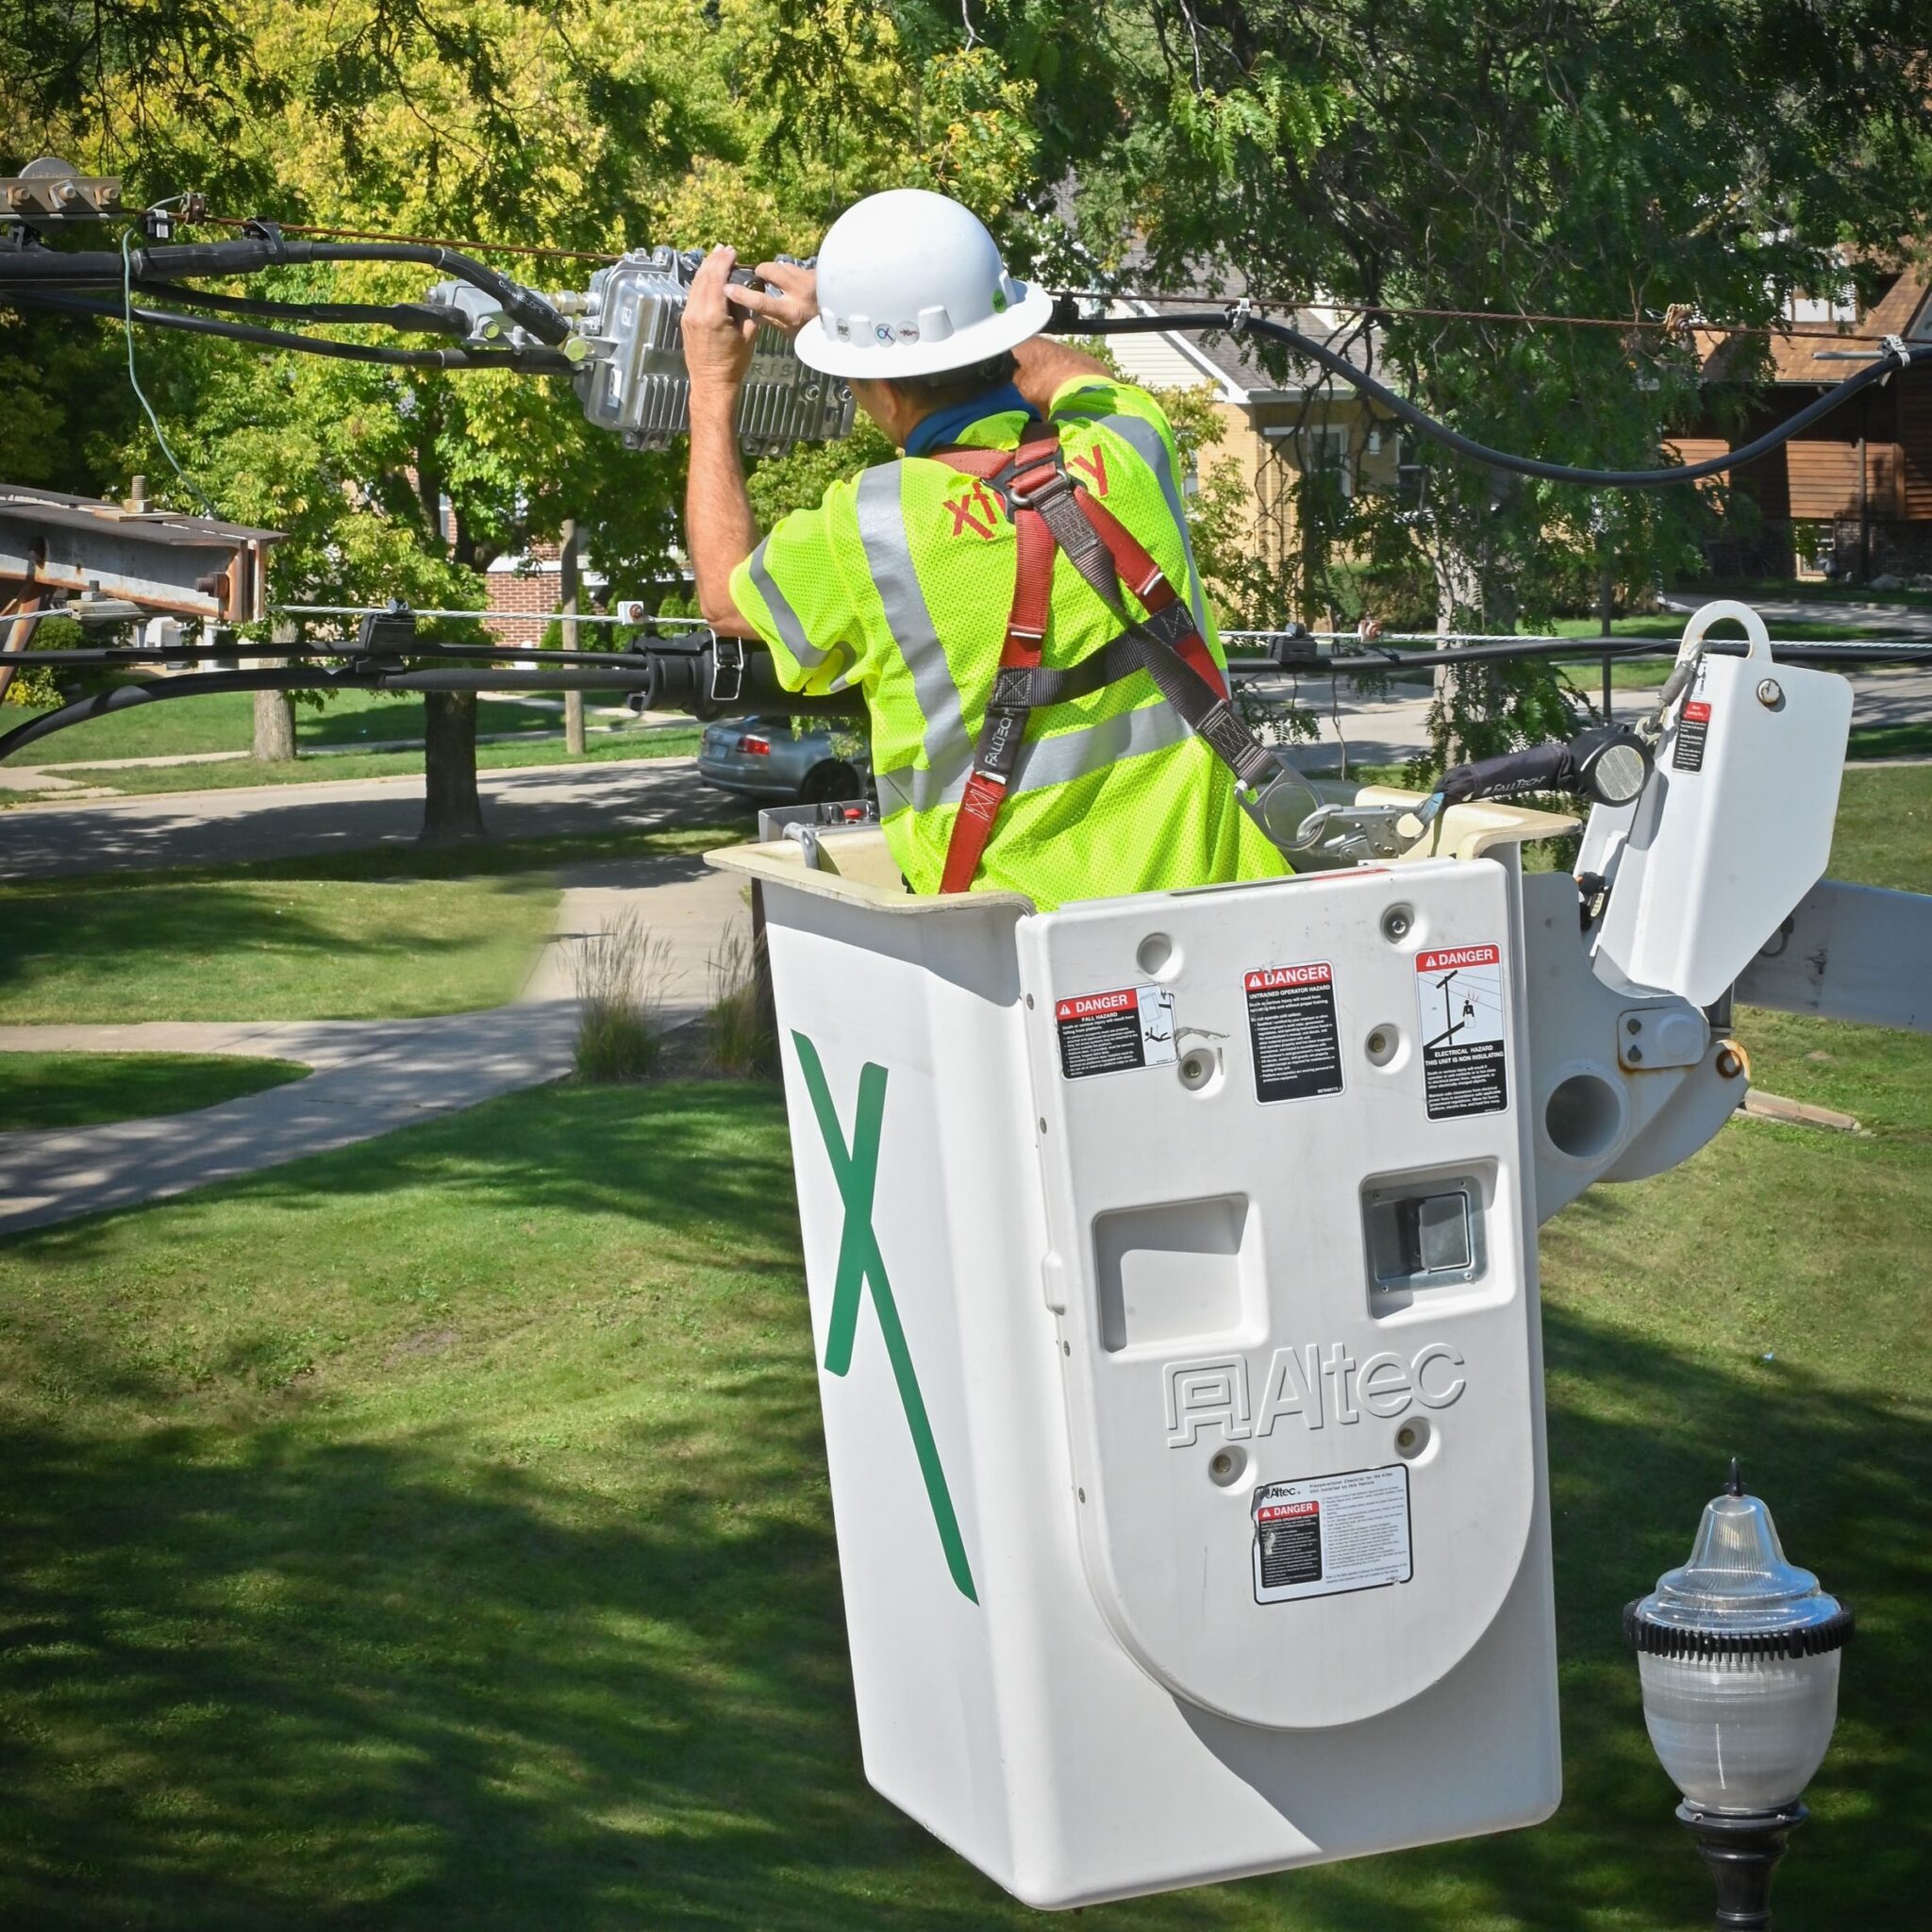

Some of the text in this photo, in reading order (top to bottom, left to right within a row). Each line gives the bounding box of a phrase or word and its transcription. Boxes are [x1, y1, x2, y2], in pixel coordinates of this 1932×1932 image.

[1439, 948, 1493, 966] DANGER
[1264, 966, 1329, 986] DANGER
[1249, 991, 1279, 1000] UNTRAINED
[1280, 988, 1307, 996] OPERATOR
[1075, 994, 1127, 1012] DANGER
[1435, 1048, 1468, 1058] ELECTRICAL
[1255, 1342, 1467, 1437] Altec
[1270, 1487, 1296, 1499] Altec
[1274, 1502, 1313, 1516] DANGER
